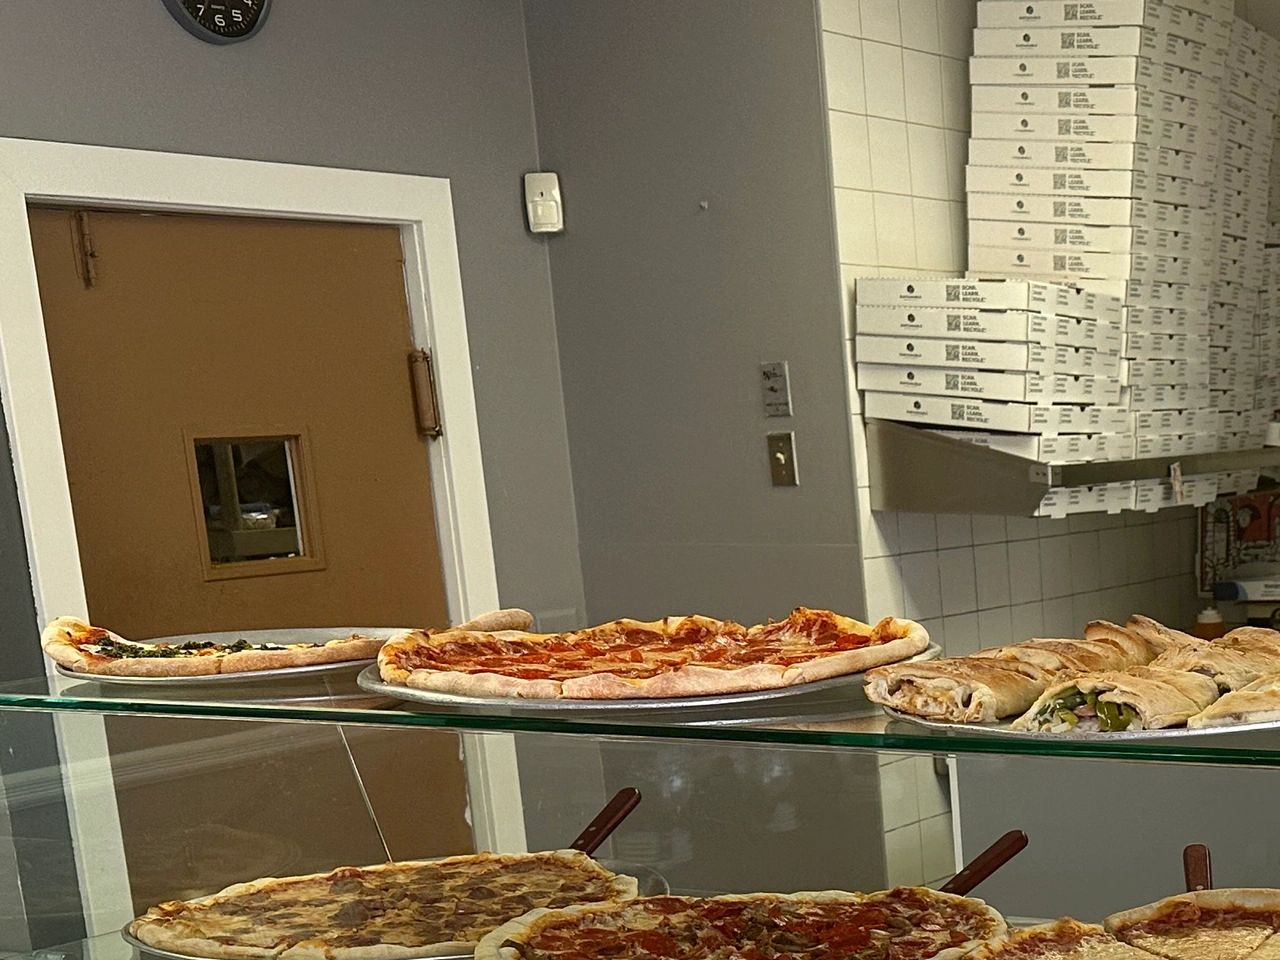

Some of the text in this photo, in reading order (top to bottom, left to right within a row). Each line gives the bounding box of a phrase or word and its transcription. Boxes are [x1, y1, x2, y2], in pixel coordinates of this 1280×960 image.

[196, 4, 204, 16] 7
[232, 10, 242, 22] 5
[214, 14, 226, 26] 6
